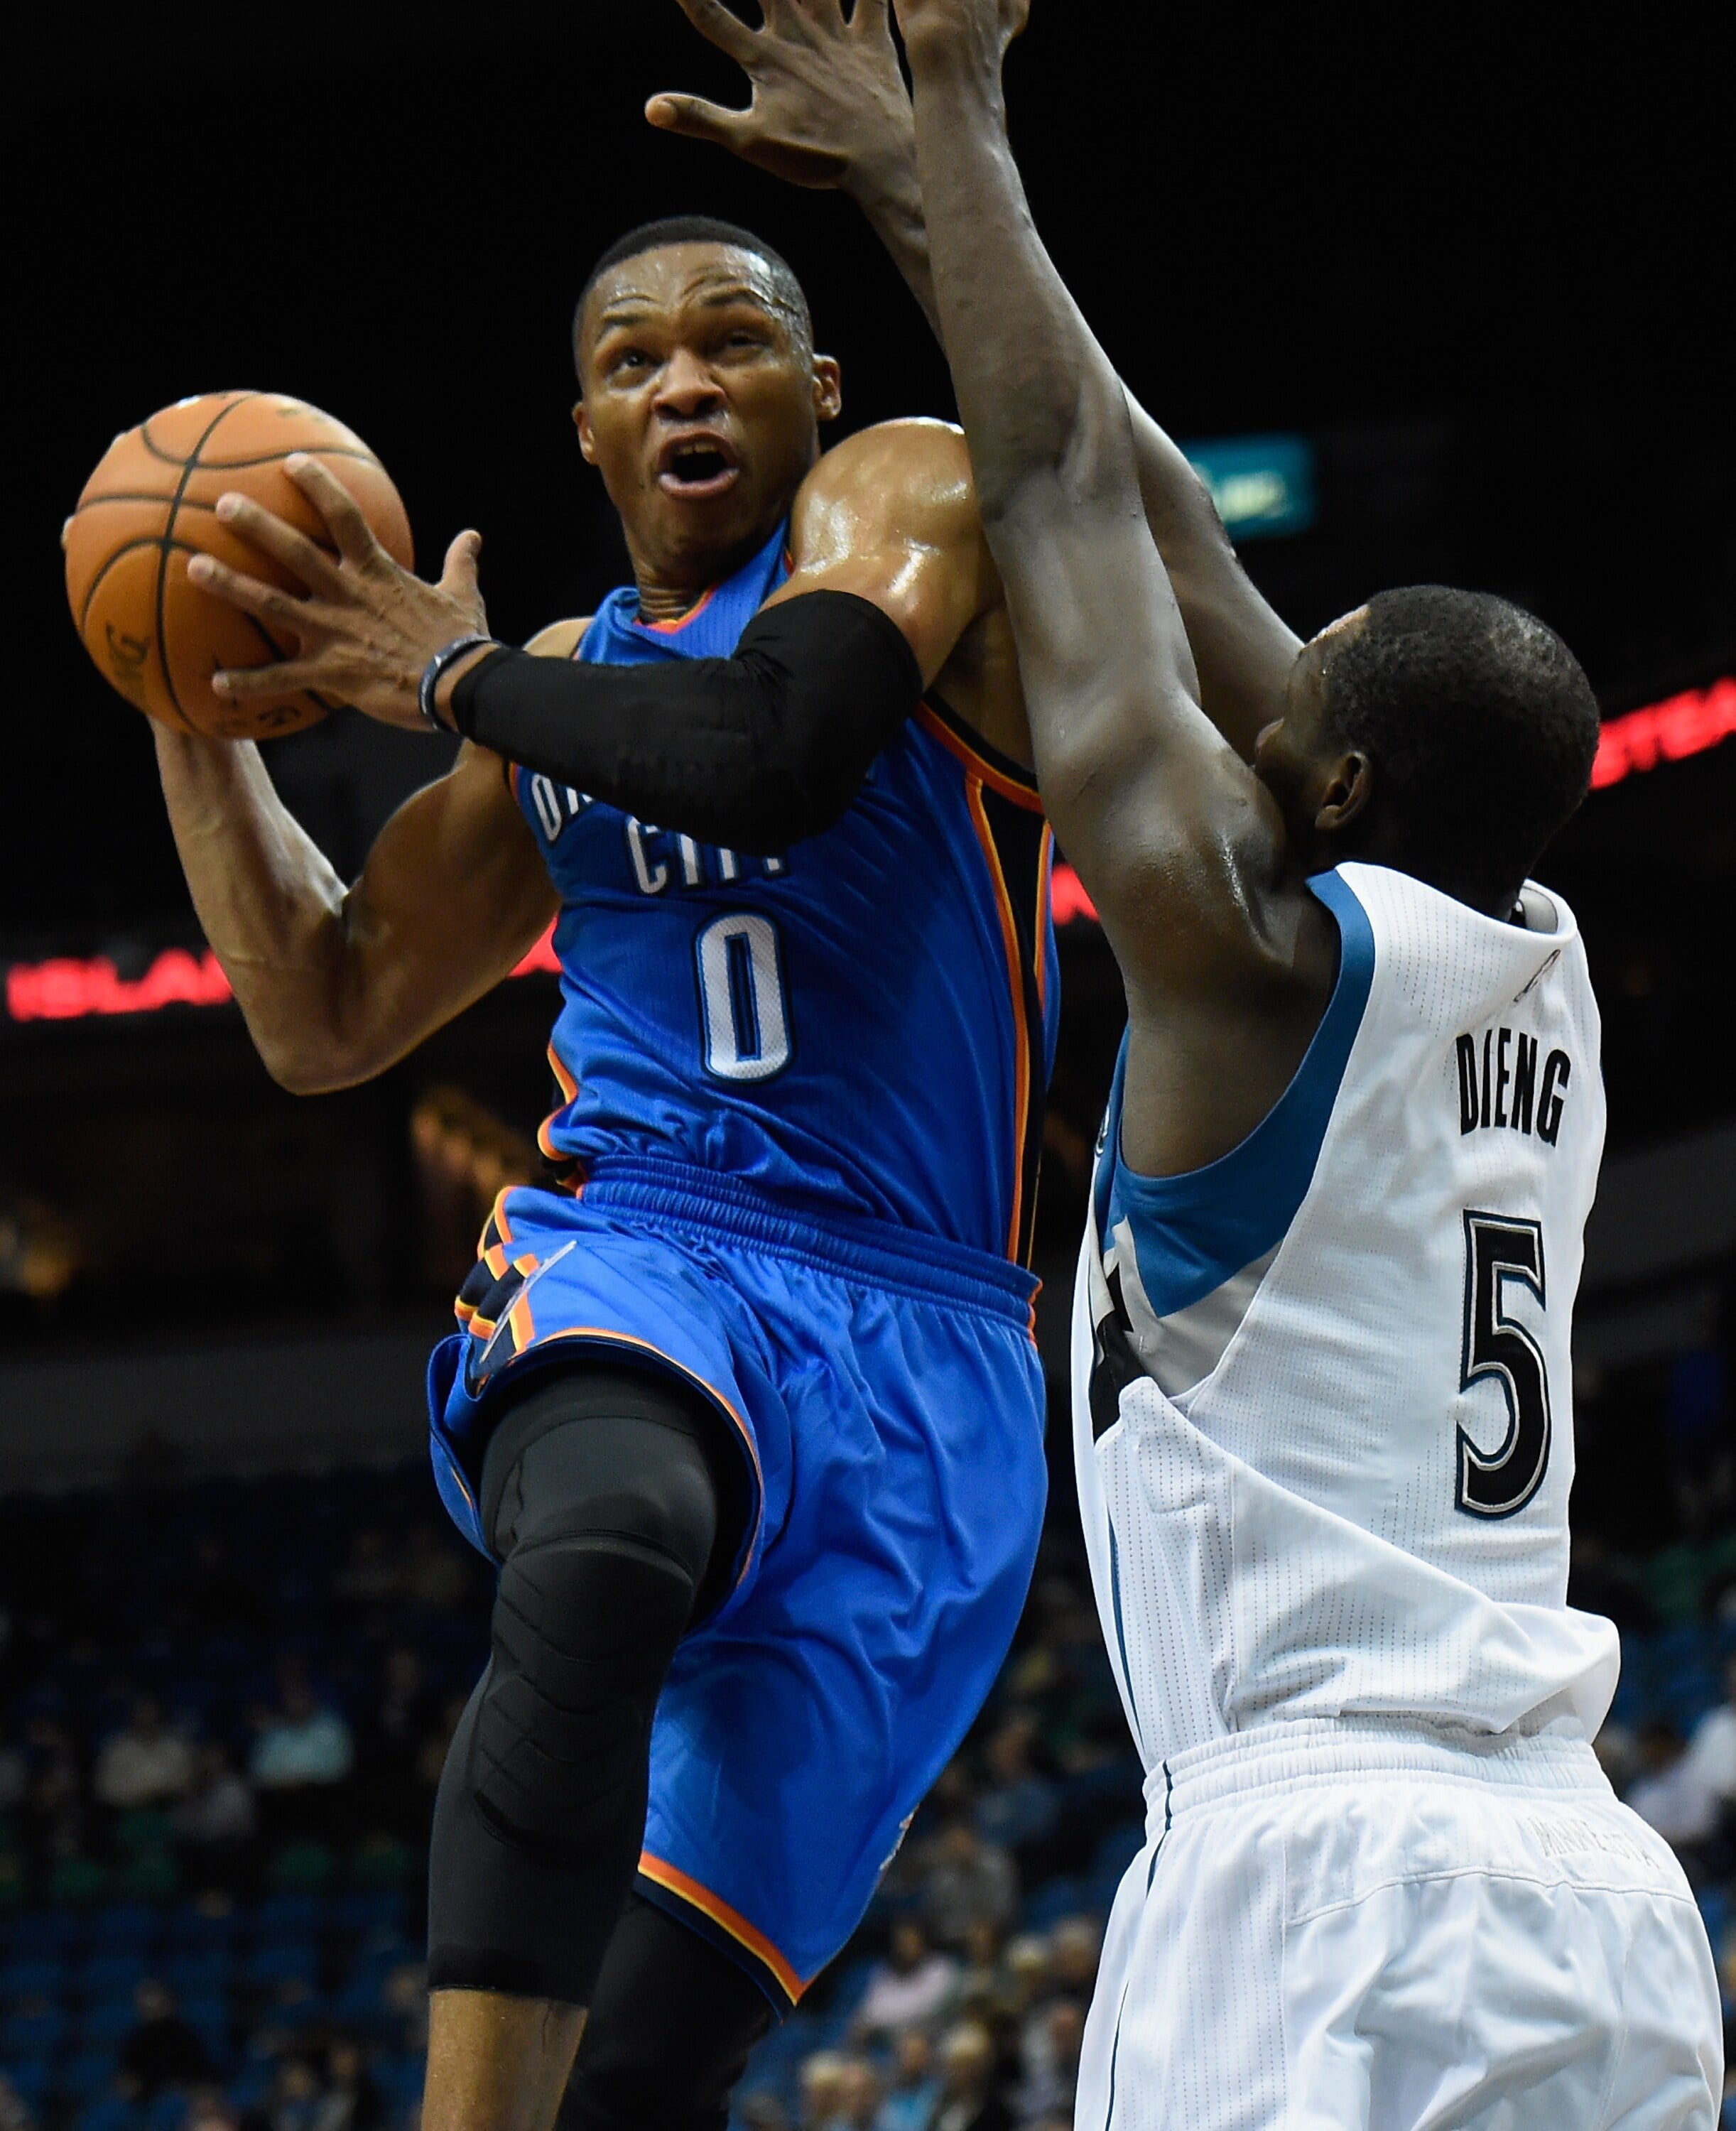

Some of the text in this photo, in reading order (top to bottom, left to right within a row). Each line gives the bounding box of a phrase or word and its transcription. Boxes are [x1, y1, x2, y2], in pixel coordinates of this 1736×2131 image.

[695, 913, 792, 1083] 0
[1455, 1027, 1571, 1148] DIENG
[1455, 1209, 1551, 1519] 5
